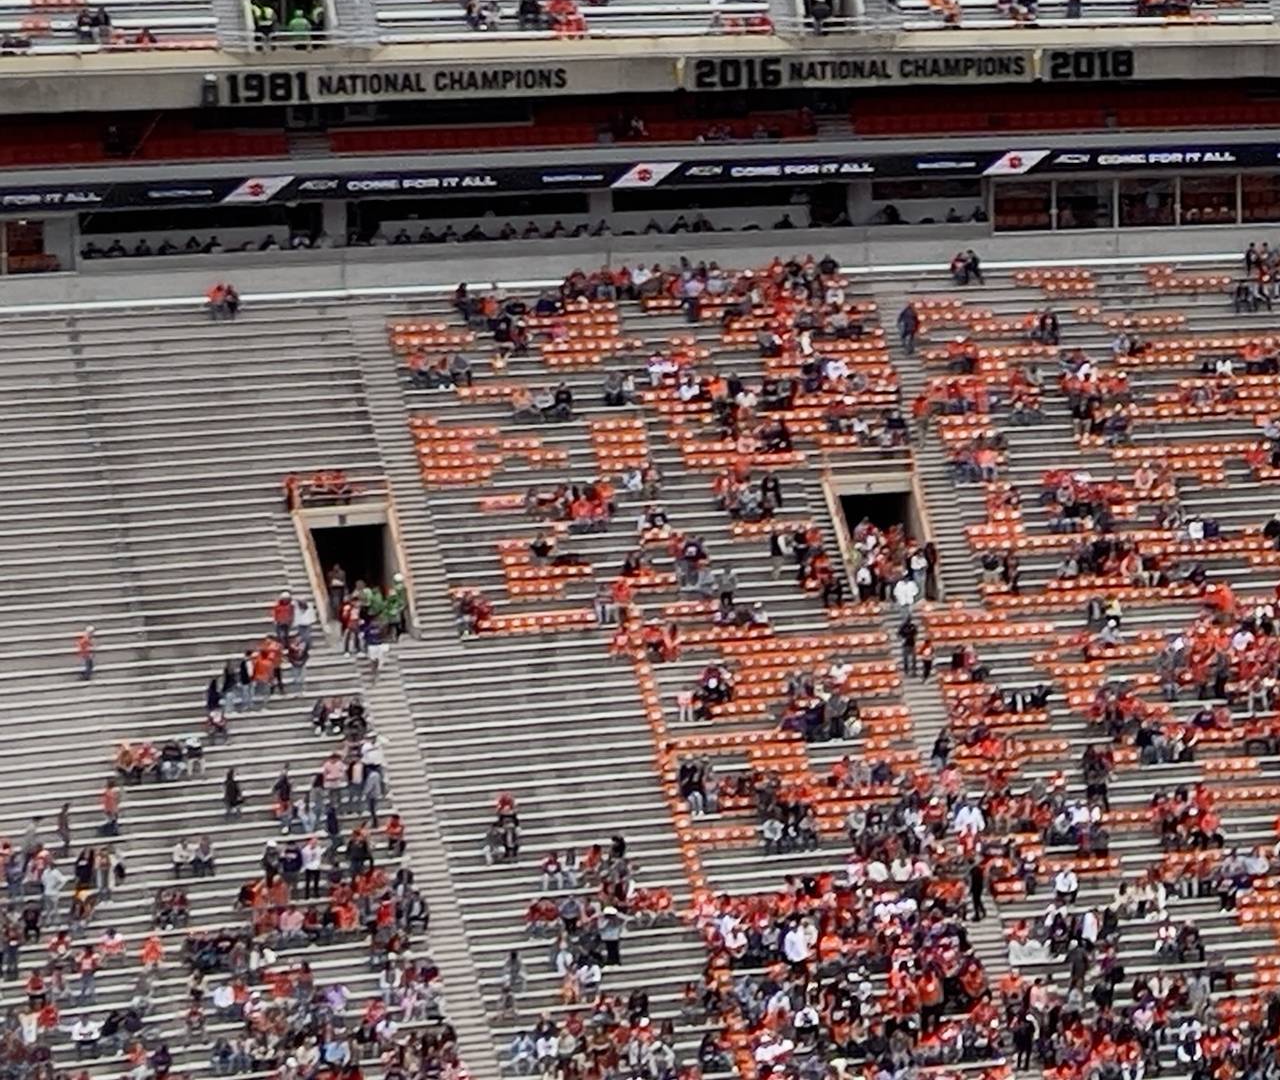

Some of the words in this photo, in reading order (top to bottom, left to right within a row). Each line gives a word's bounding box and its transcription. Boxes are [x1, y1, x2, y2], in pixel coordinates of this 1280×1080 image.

[695, 57, 783, 90] 2016
[789, 57, 893, 82] NATIONAL
[899, 53, 1026, 78] CHAMPIONS
[1050, 50, 1135, 79] 2018
[226, 71, 311, 105] 1981
[318, 72, 427, 97] NATIONAL
[434, 68, 568, 93] CHAMPIONS
[1203, 151, 1236, 162] ALL
[840, 162, 875, 173] ALL
[462, 175, 497, 187] ALL
